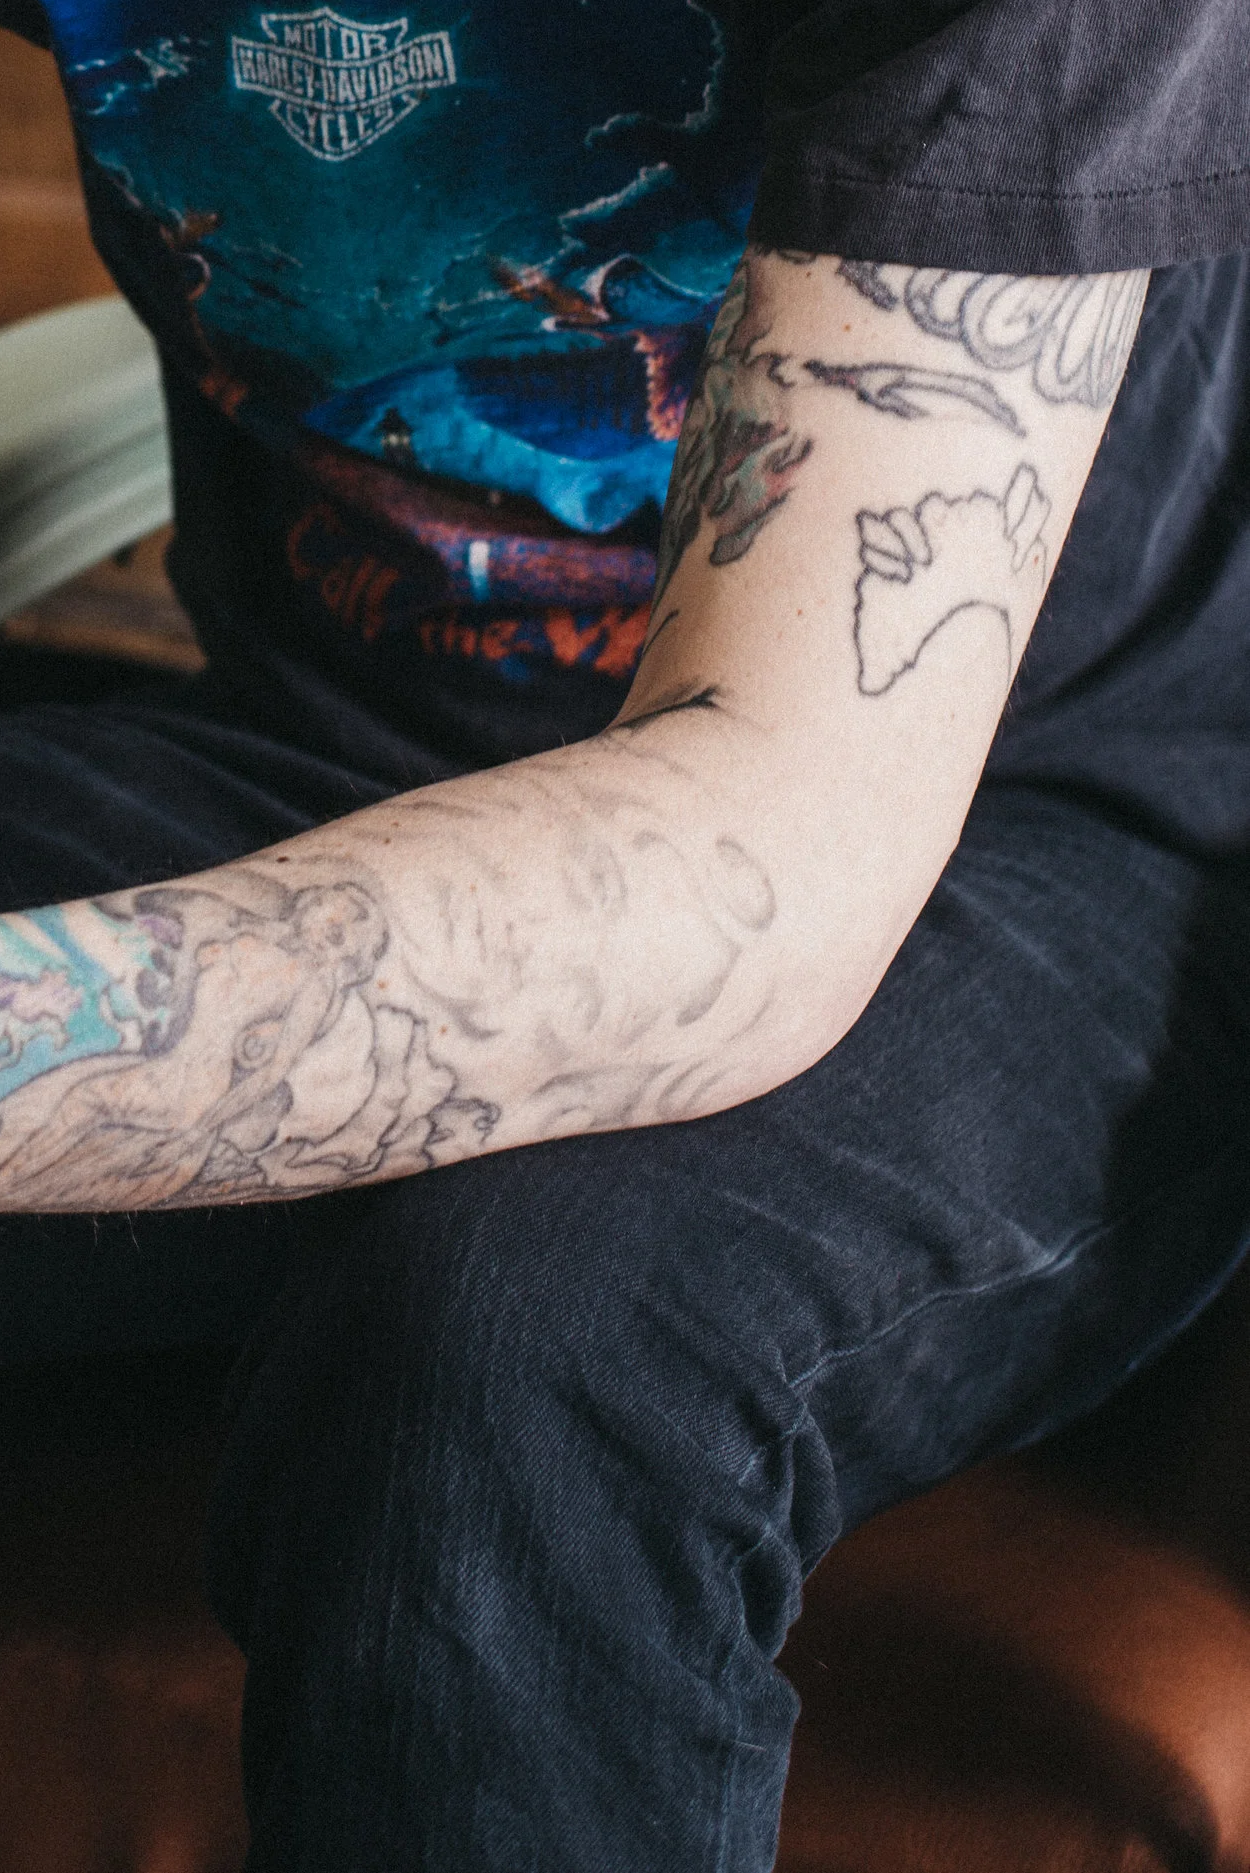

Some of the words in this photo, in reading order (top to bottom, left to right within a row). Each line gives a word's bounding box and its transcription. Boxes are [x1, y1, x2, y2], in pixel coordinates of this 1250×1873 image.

[283, 19, 388, 60] MOTOR
[238, 41, 446, 104] HARLEY-DAVIDSON
[285, 100, 394, 153] CYCLES
